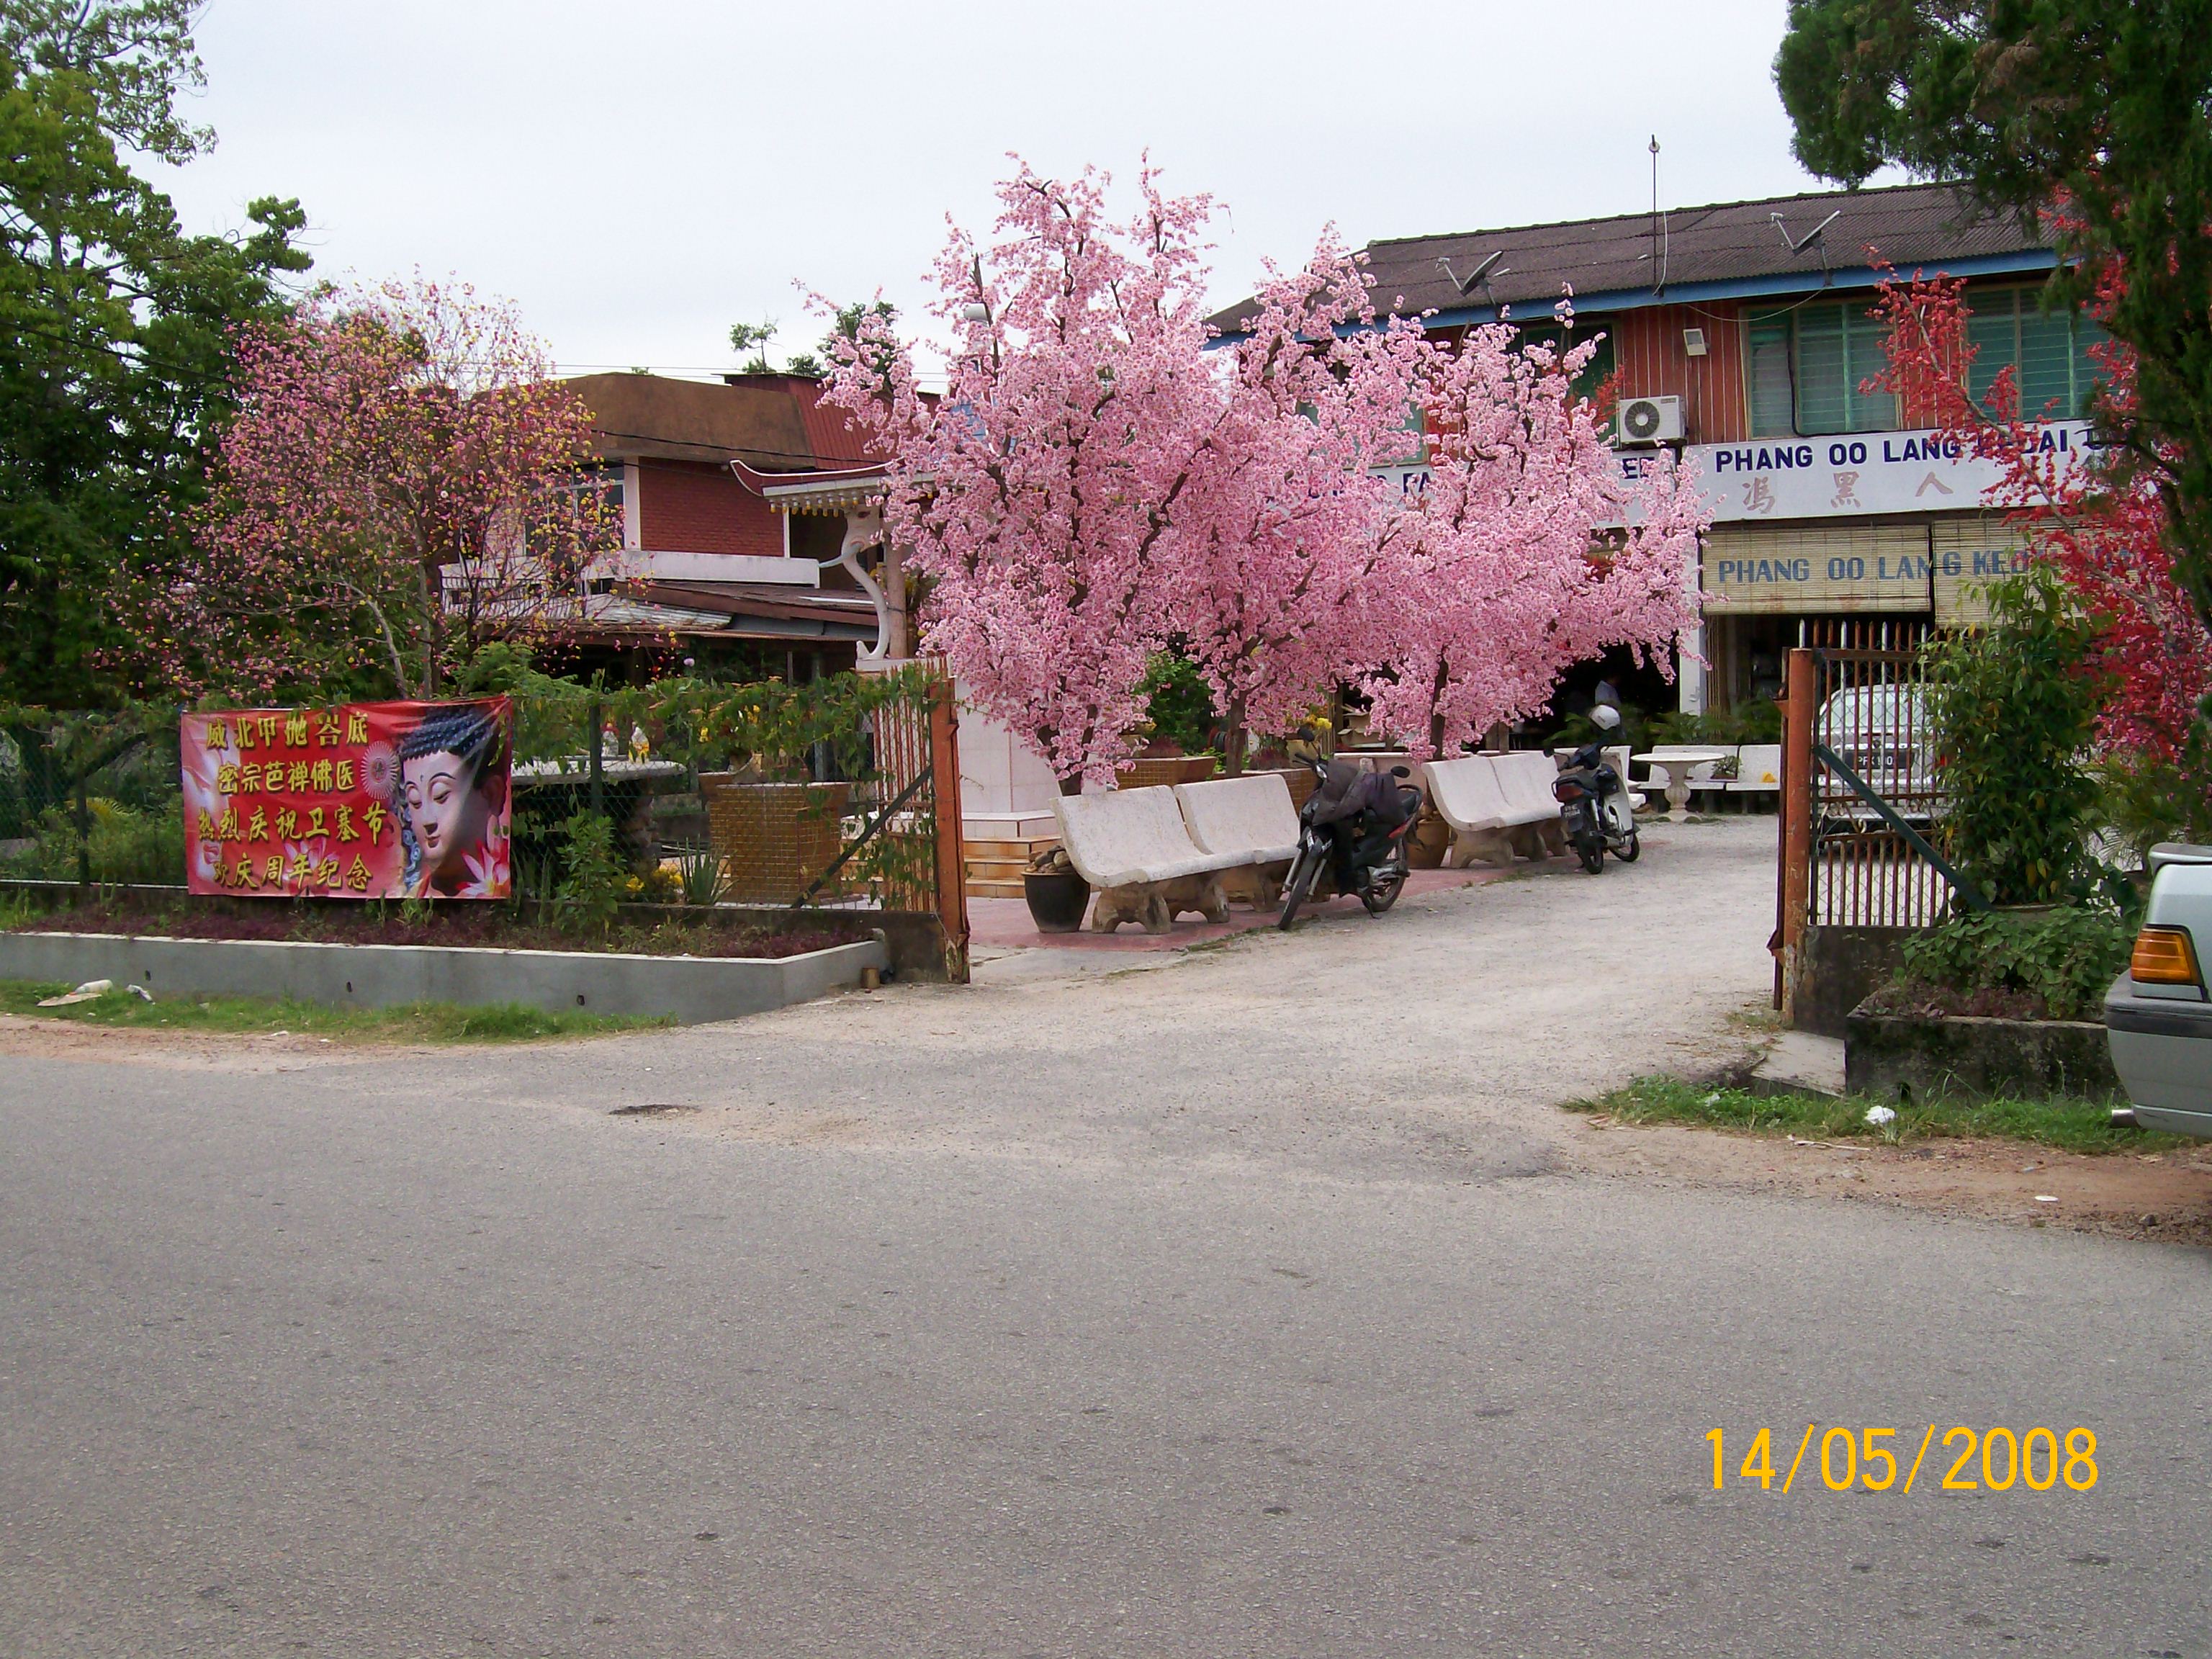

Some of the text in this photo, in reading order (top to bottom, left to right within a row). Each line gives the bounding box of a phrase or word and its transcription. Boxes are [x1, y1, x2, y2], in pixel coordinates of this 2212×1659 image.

[1715, 445, 1813, 472] PHANG
[1829, 441, 1867, 466] OO
[1884, 436, 1961, 462] LANG
[1718, 557, 1809, 583] PHANG
[1827, 557, 1865, 580] OO
[1879, 552, 1962, 580] LANG
[198, 801, 387, 845] 热烈庆祝卫塞节
[213, 852, 373, 890] 欢庆周年纪念
